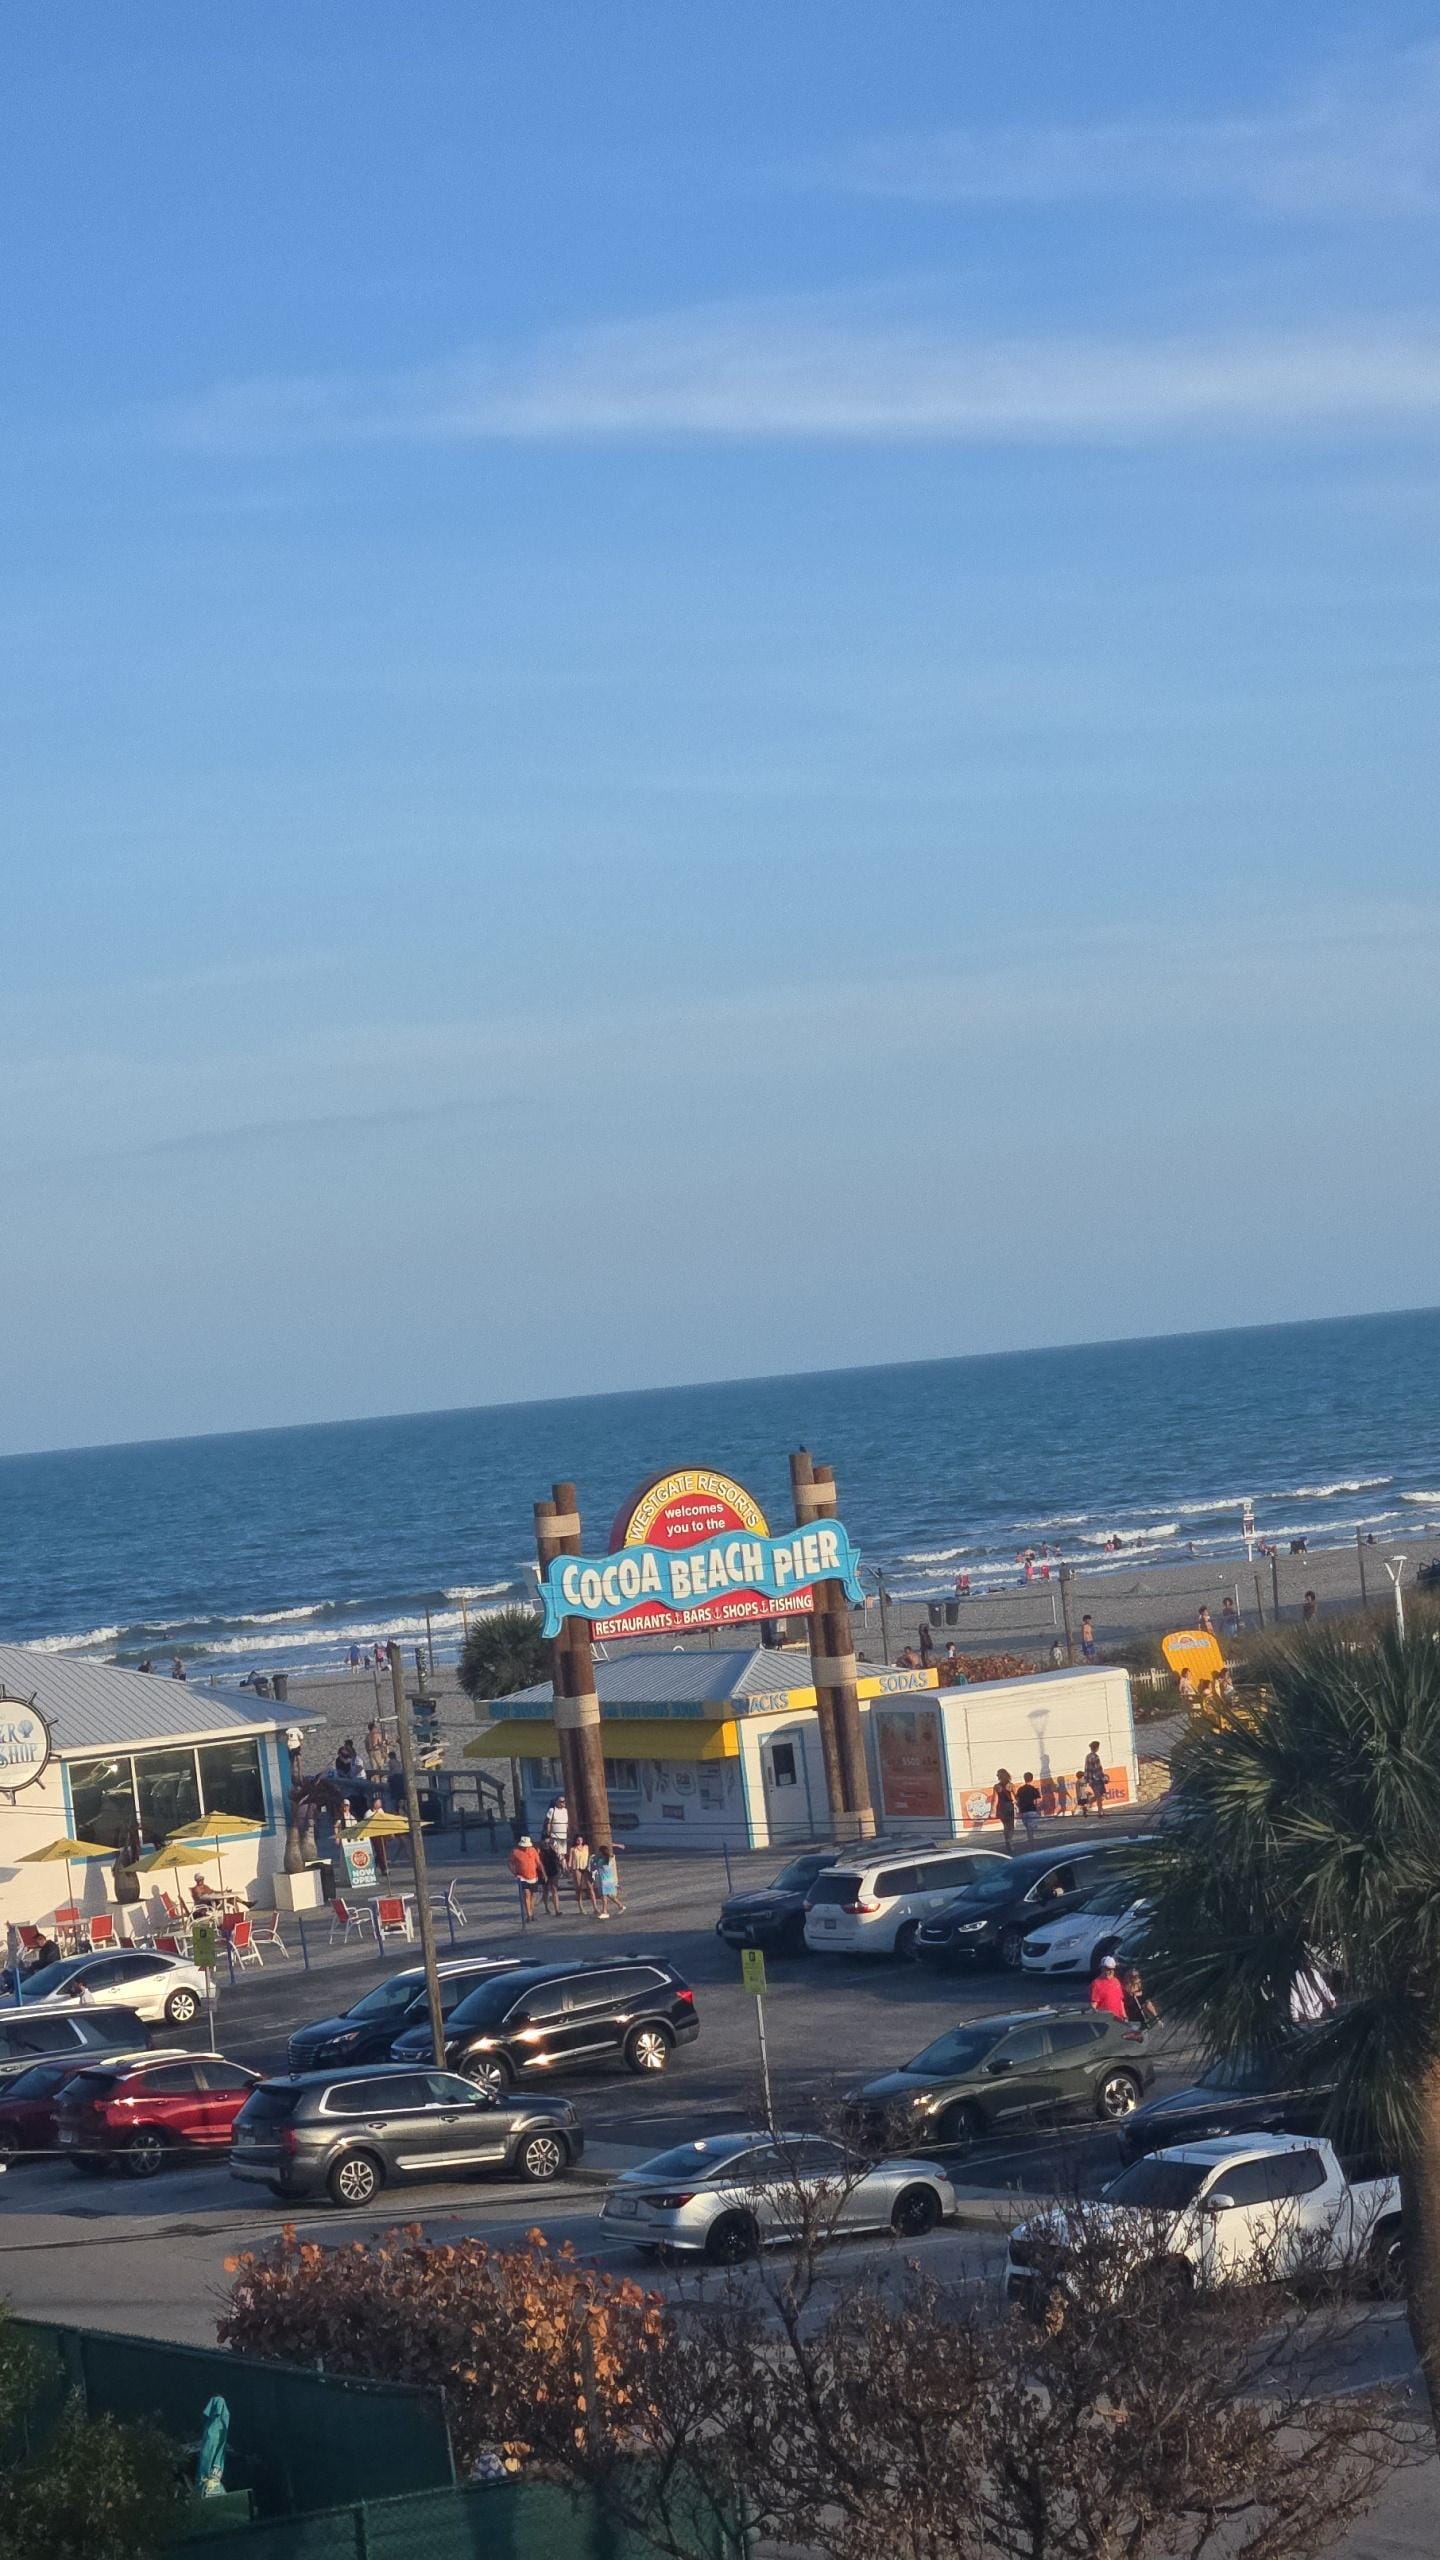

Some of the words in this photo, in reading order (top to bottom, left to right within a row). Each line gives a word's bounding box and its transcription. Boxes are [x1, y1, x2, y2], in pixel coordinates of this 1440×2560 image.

[630, 1475, 694, 1540] WESTGATE
[697, 1475, 759, 1527] RESORTS
[665, 1503, 724, 1519] welcomes
[667, 1522, 689, 1537] you
[691, 1520, 704, 1532] to
[706, 1518, 726, 1530] the
[562, 1552, 661, 1609] COCOA
[669, 1542, 764, 1600] BEACH
[772, 1530, 841, 1587] PIER
[595, 1612, 673, 1636] RESTAURANTS
[683, 1607, 711, 1625] BARS
[722, 1601, 759, 1619] SHOPS
[769, 1594, 813, 1612] FISHING
[879, 1672, 928, 1693] SODAS
[352, 1868, 375, 1877] NOW
[352, 1875, 377, 1885] OPEN
